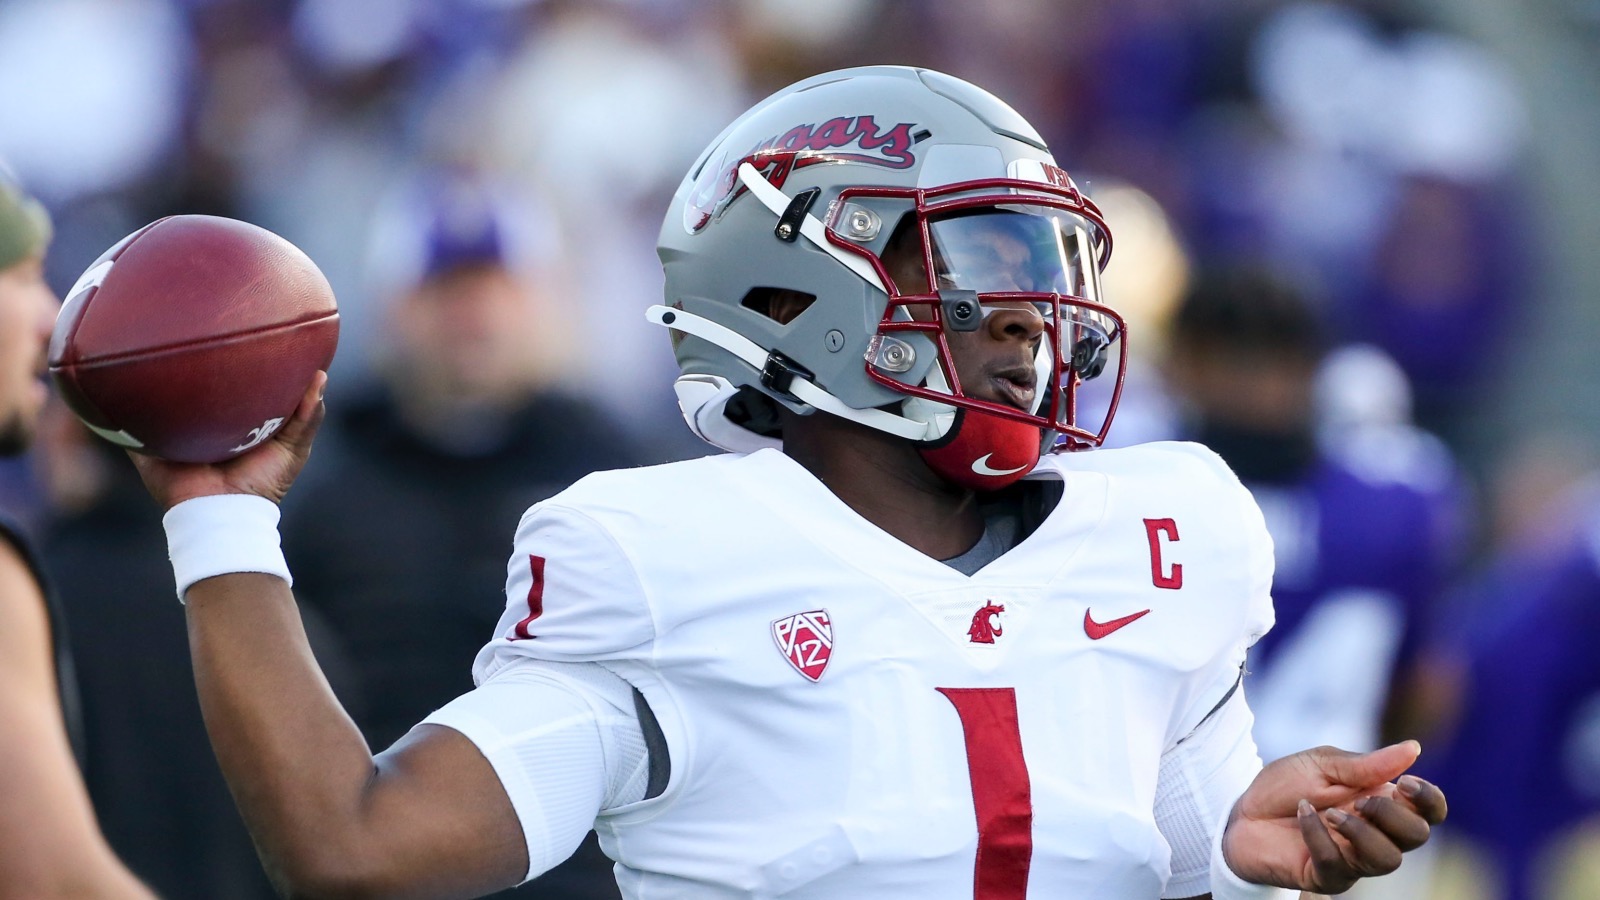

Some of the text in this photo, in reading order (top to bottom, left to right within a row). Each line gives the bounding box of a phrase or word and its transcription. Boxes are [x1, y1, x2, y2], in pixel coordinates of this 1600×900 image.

[1143, 518, 1182, 589] C
[774, 613, 832, 657] PAC
[794, 640, 827, 668] 12
[935, 687, 1032, 900] 1
